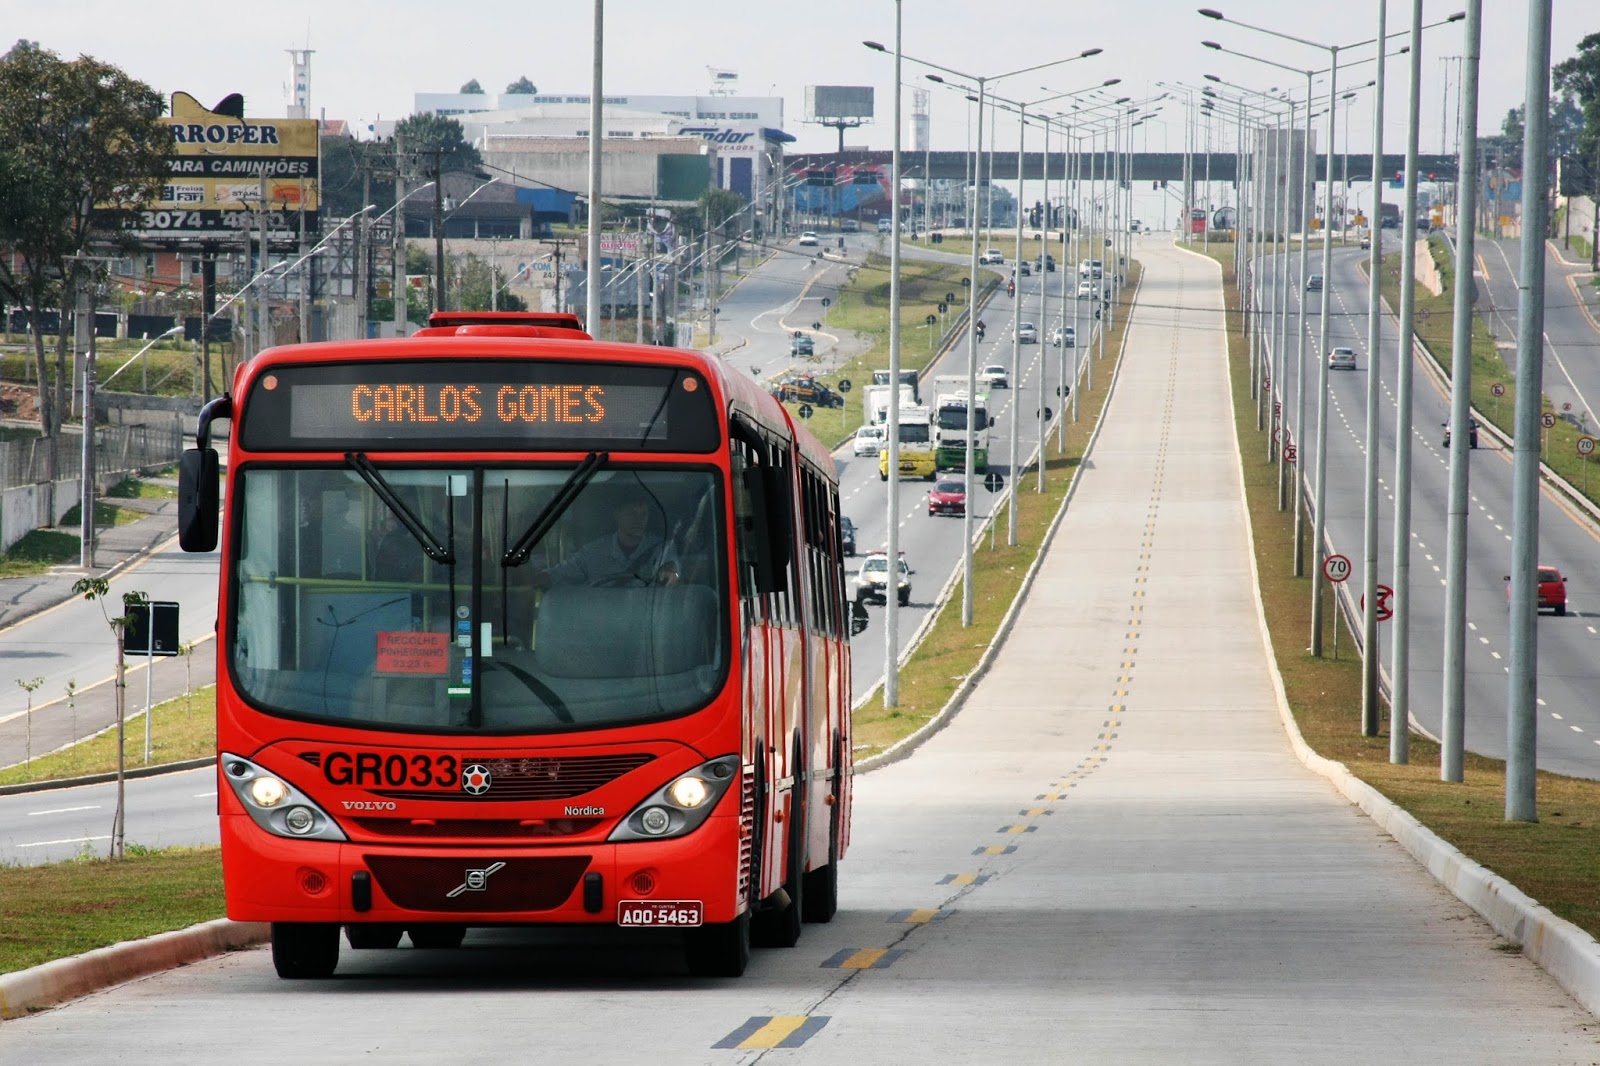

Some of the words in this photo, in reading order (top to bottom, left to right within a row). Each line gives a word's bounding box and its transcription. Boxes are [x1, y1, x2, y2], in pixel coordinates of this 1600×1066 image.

[211, 158, 309, 174] CAMINHÕES
[352, 384, 482, 422] CARLOS
[497, 384, 605, 422] GOMES
[1580, 440, 1592, 449] 70
[1329, 560, 1347, 573] 70
[387, 635, 437, 645] RECOLHE
[380, 647, 443, 657] PINHEIRINHO
[323, 751, 458, 788] GR033
[341, 801, 397, 810] VOLVO
[564, 805, 604, 816] Nórdica
